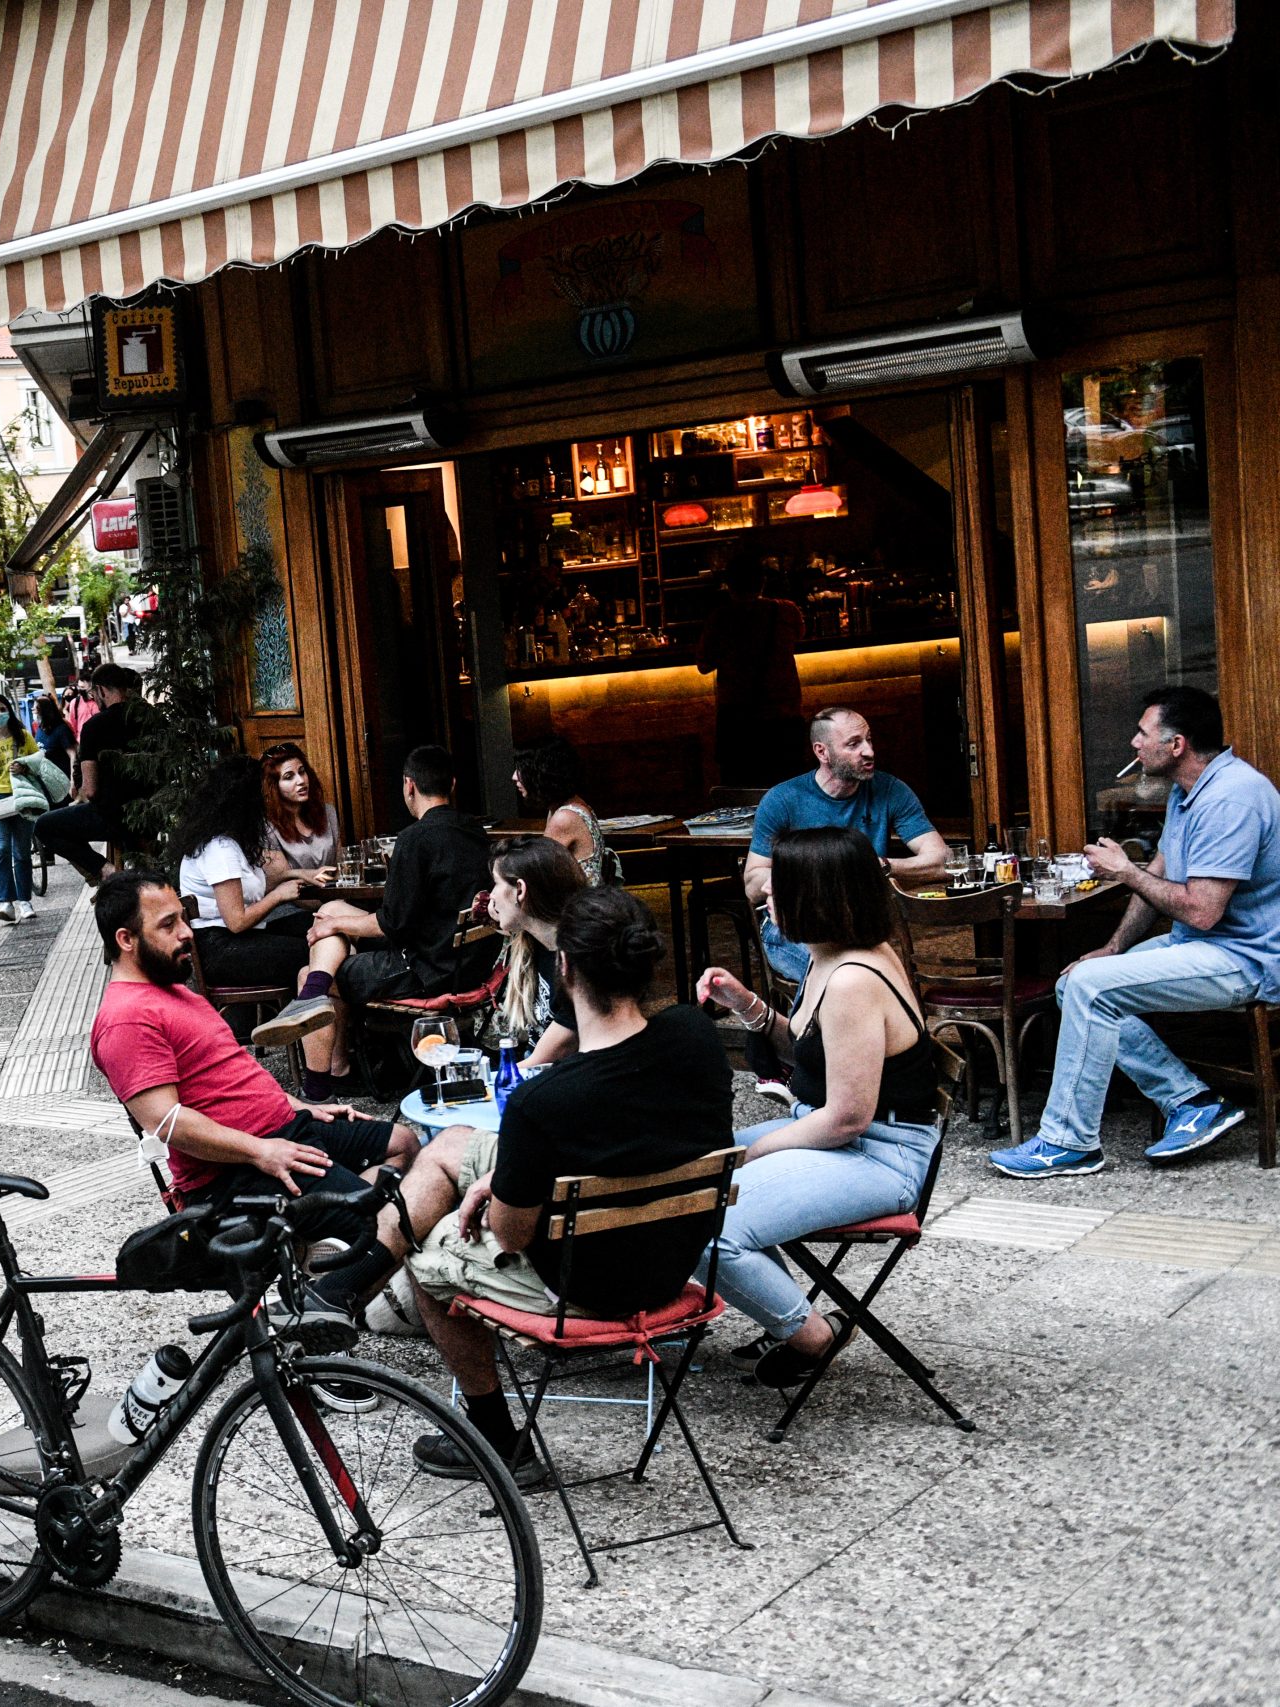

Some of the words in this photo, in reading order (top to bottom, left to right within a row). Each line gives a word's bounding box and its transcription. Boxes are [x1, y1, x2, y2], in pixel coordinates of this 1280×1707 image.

[112, 312, 164, 325] Coffee
[113, 375, 170, 391] Republic
[129, 1401, 149, 1420] TREK
